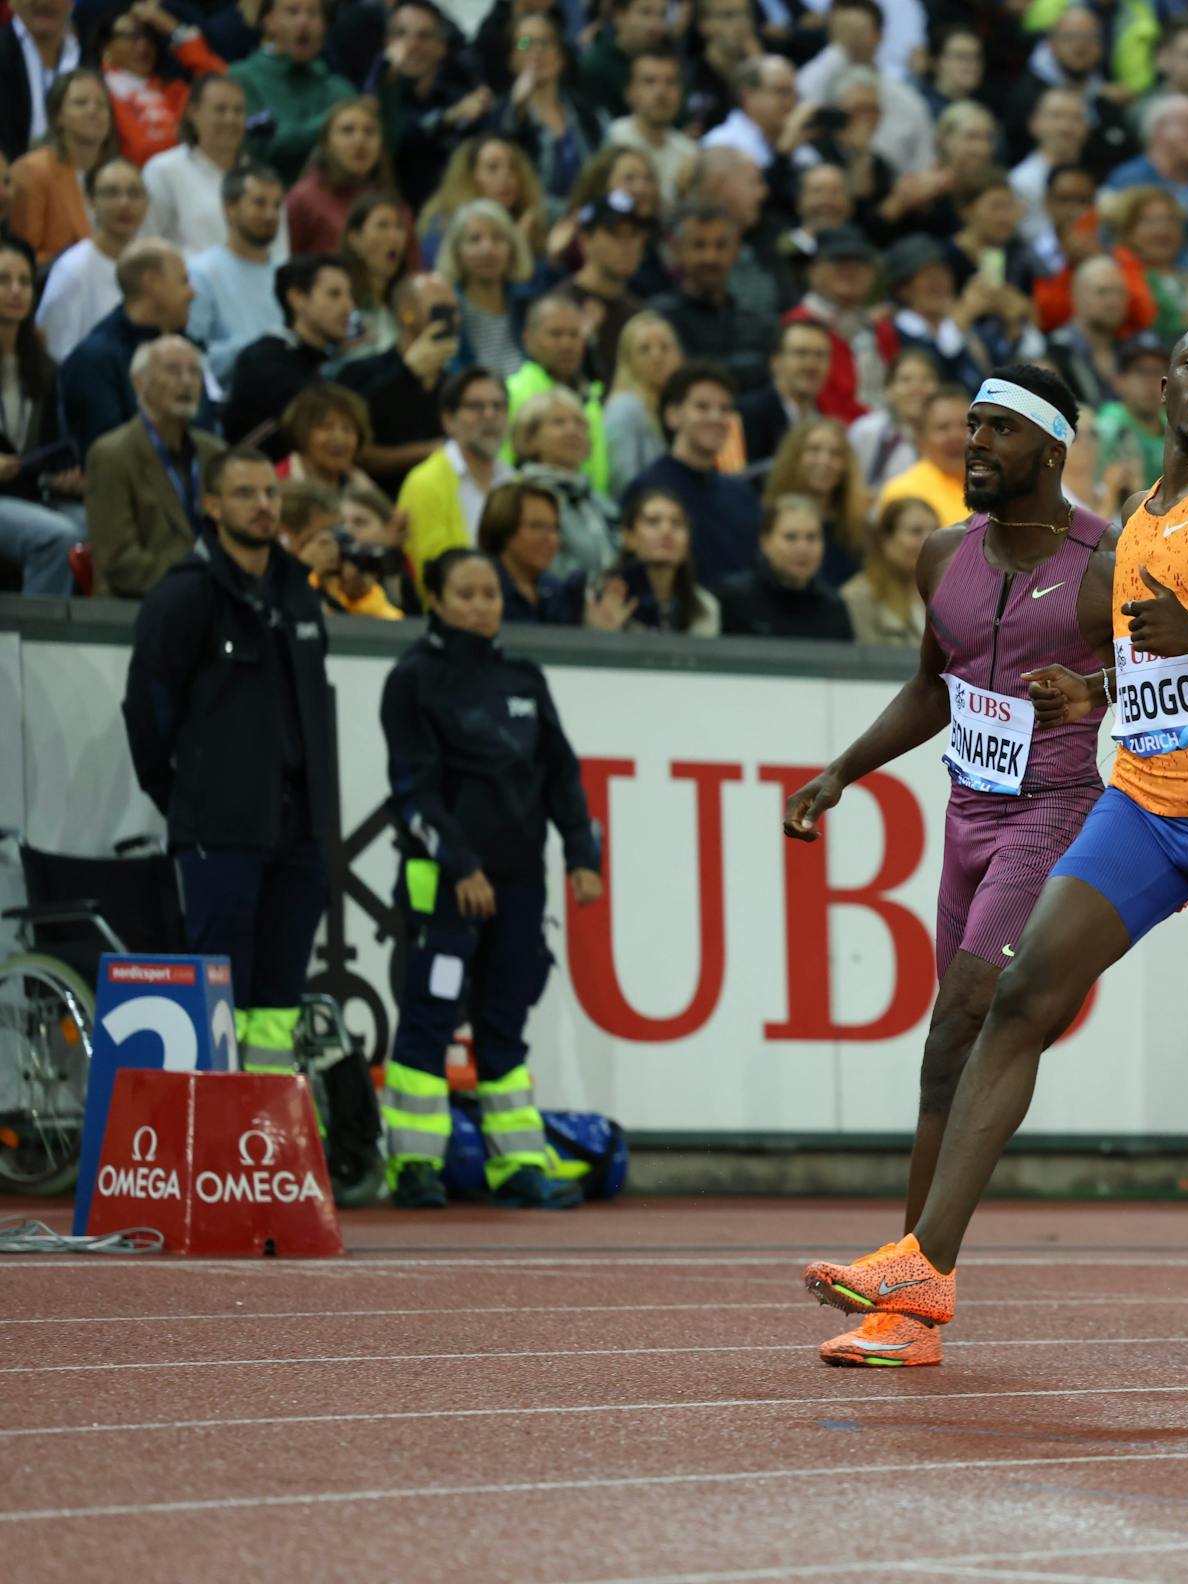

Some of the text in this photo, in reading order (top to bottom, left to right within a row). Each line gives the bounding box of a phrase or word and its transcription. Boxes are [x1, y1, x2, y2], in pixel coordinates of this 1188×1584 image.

[968, 691, 1011, 722] UBS
[1129, 732, 1180, 753] ZURICH
[566, 757, 1099, 1048] UB
[98, 1164, 181, 1200] OMEGA
[195, 1170, 324, 1203] OMEGA
